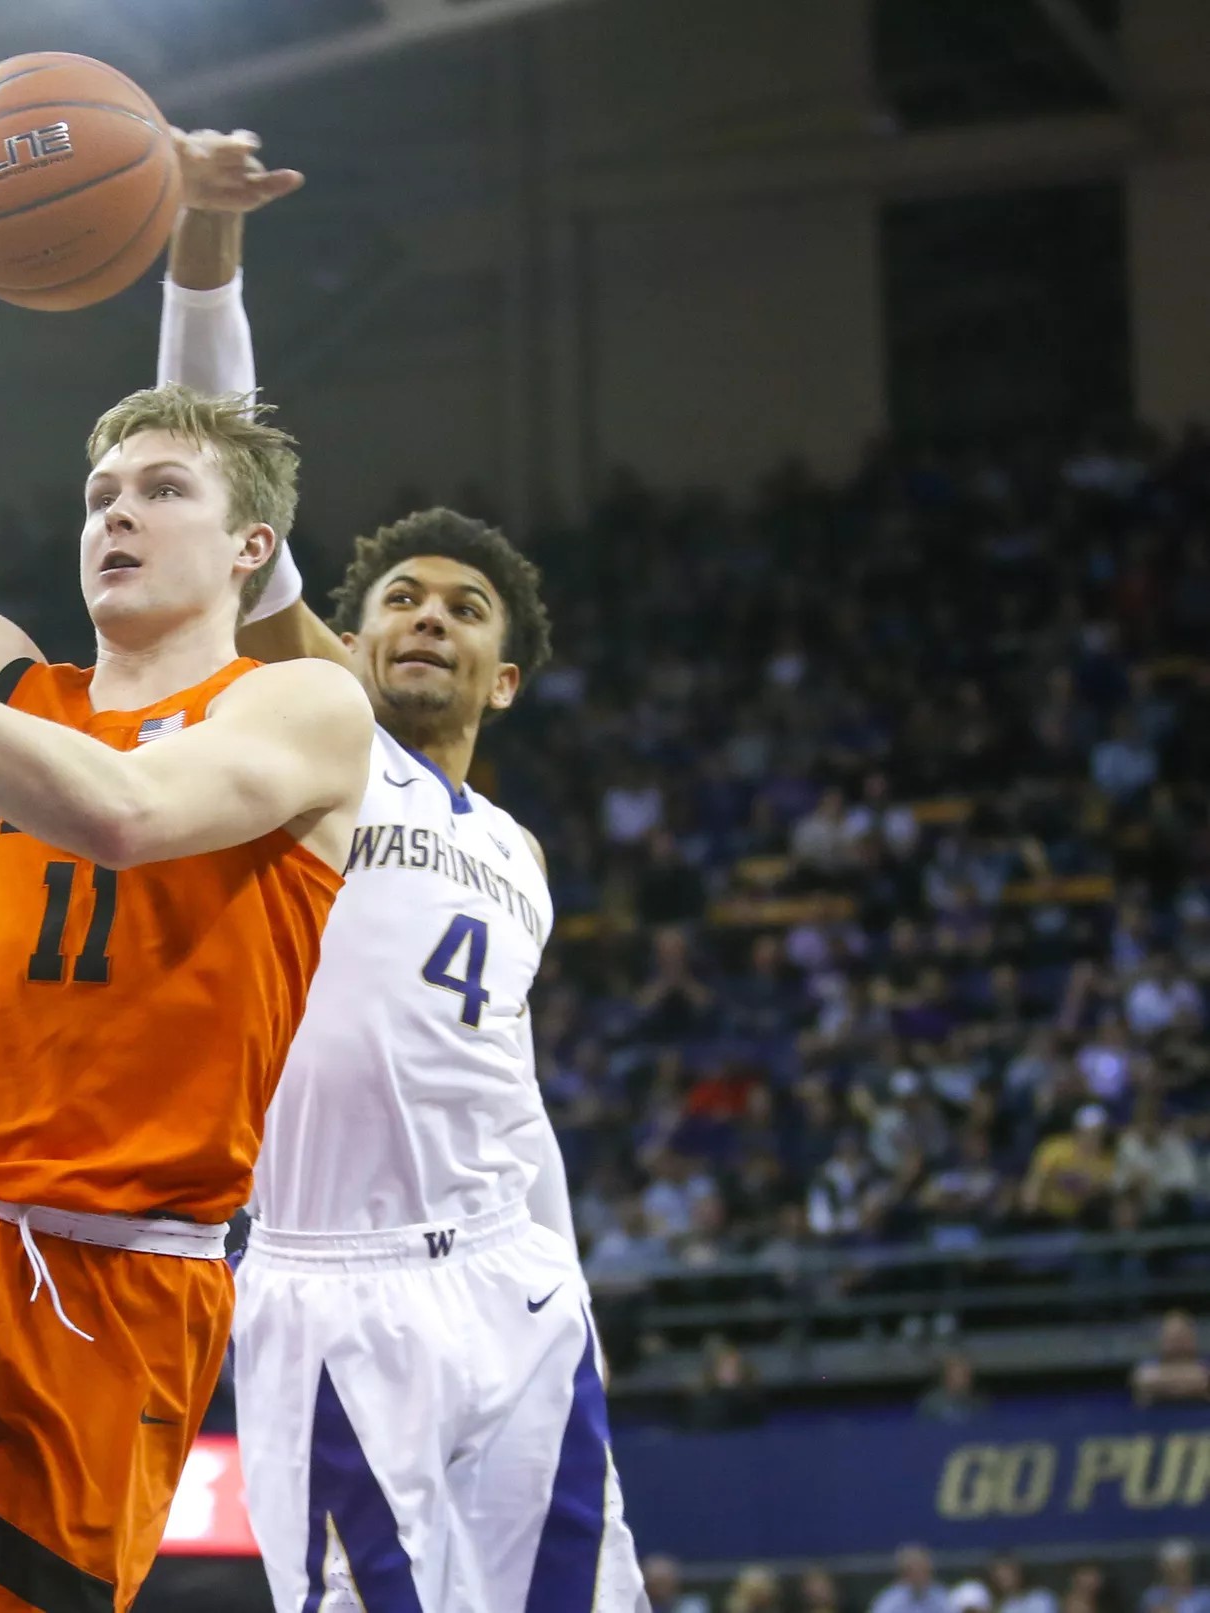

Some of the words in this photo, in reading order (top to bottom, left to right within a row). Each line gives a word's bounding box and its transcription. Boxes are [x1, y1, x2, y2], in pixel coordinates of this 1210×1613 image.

[27, 861, 119, 984] 11
[421, 912, 490, 1032] 4
[423, 1228, 456, 1259] W
[937, 1441, 1058, 1520] GO
